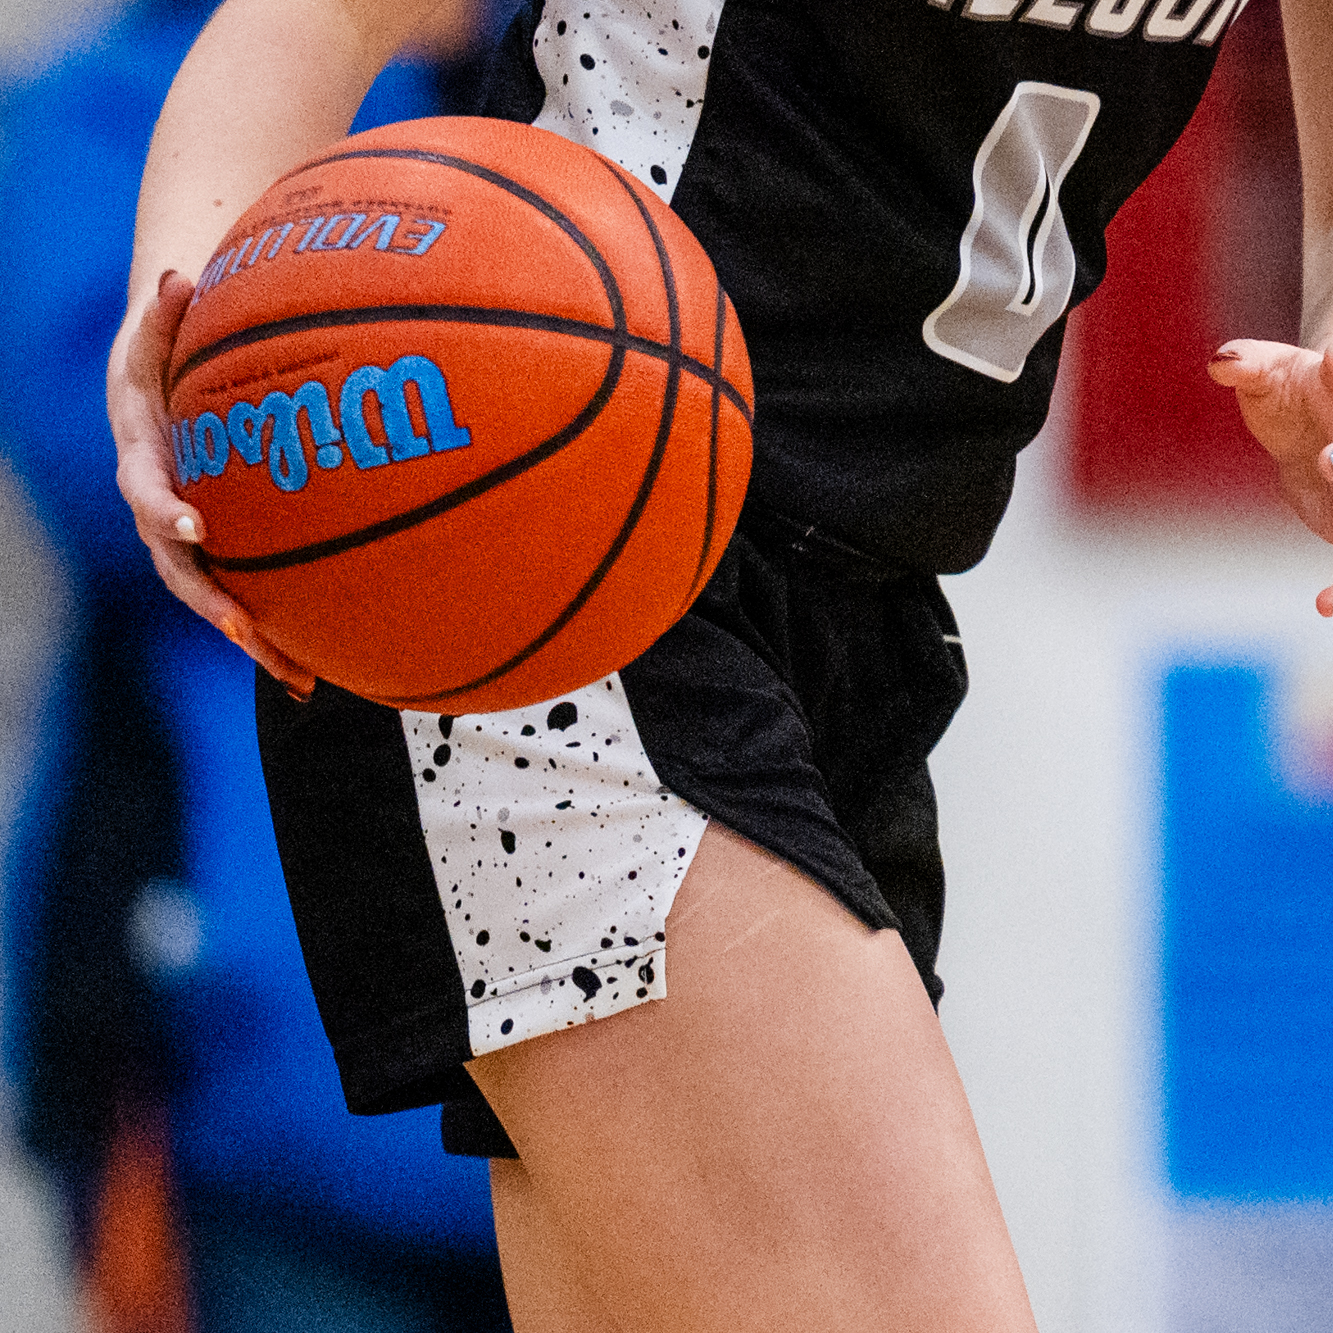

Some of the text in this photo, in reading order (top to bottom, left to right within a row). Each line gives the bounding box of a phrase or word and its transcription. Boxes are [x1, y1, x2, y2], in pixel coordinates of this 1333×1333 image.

[191, 213, 448, 305] EVOLUTI
[923, 81, 1101, 383] 0
[172, 355, 471, 491] Wilson
